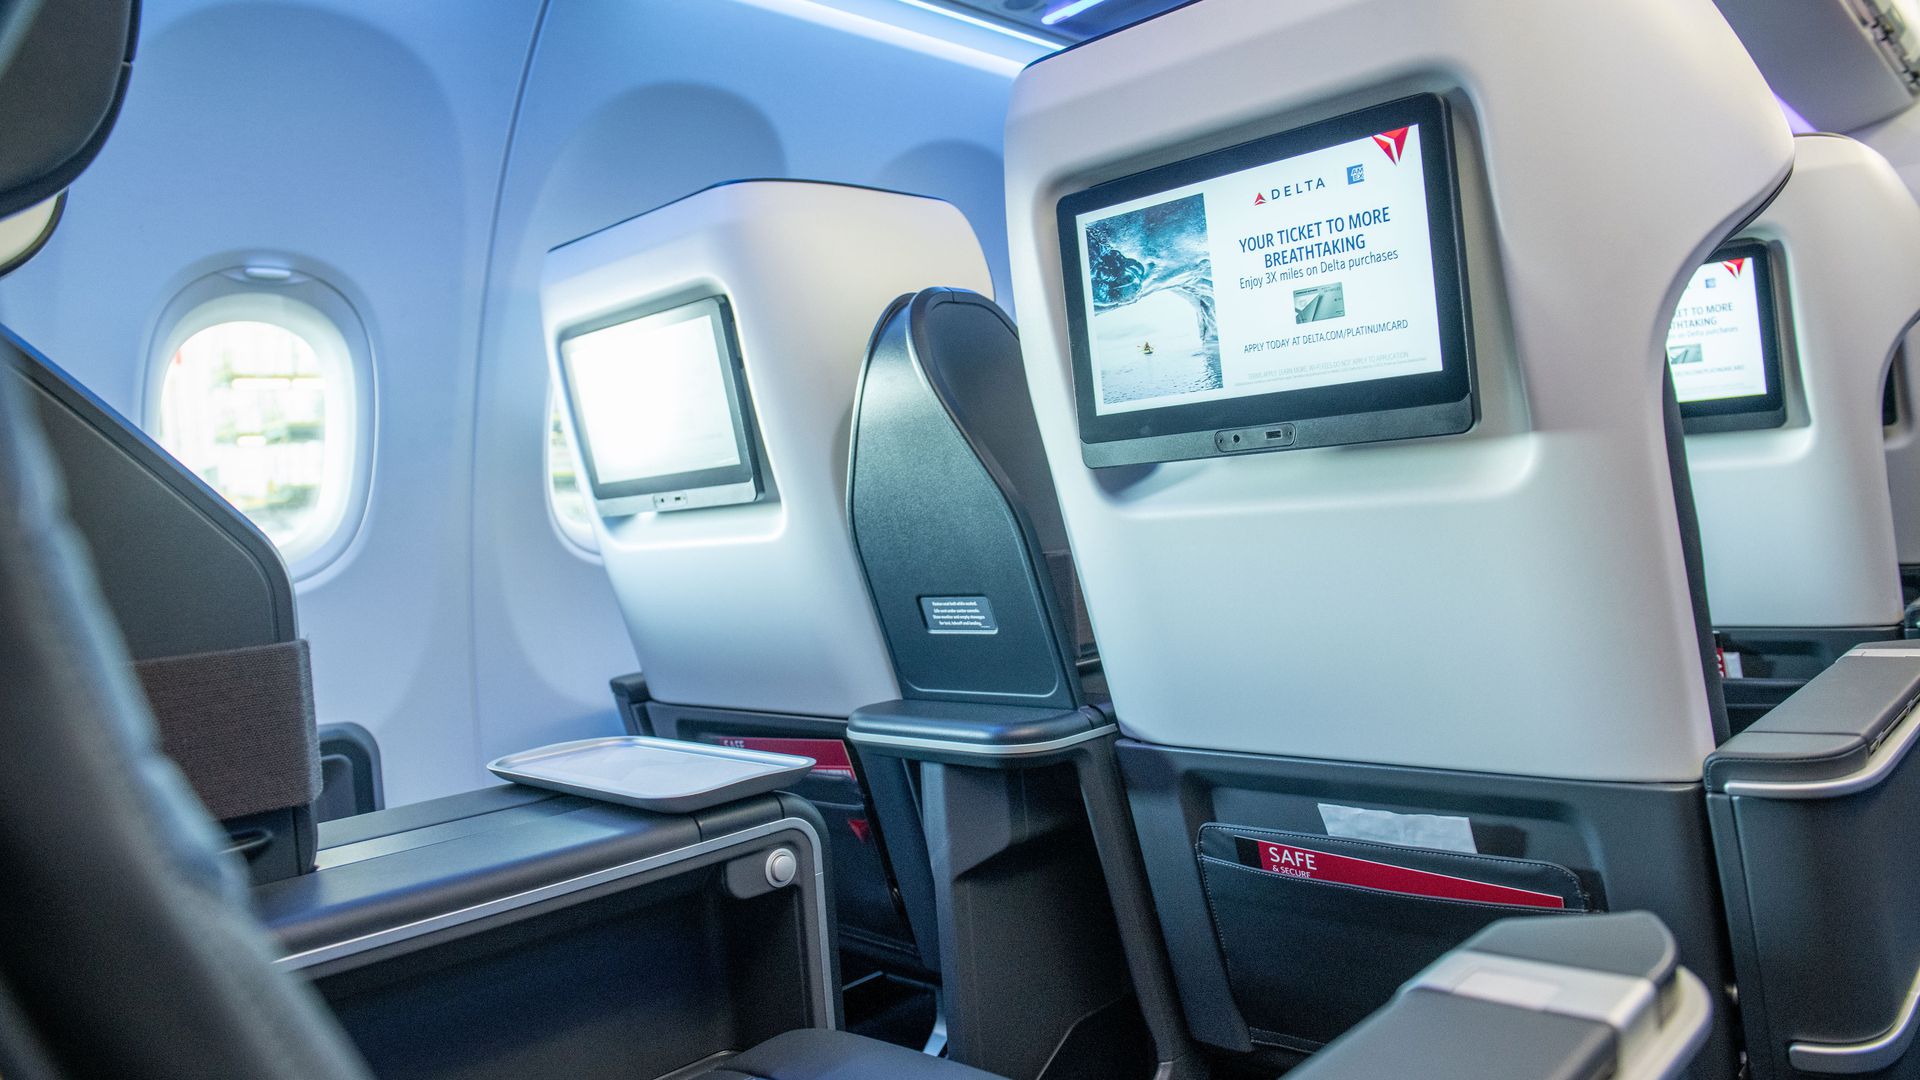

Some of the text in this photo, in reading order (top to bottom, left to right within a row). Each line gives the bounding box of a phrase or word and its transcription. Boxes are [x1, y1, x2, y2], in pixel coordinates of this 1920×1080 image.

[1271, 177, 1325, 200] DELTA
[1239, 206, 1391, 253] YOUR TICKET TO MORE
[1264, 233, 1366, 268] BREATHTAKING
[1239, 248, 1399, 291] Enjoy 3X miles on Delta purchases
[1692, 305, 1704, 316] TO
[1706, 302, 1734, 314] MORE
[1243, 319, 1409, 354] APPLY TODAY AT DELTA.COM/PLATINUMCARD
[1268, 847, 1317, 870] SAFE
[1272, 864, 1311, 879] & SECURE
